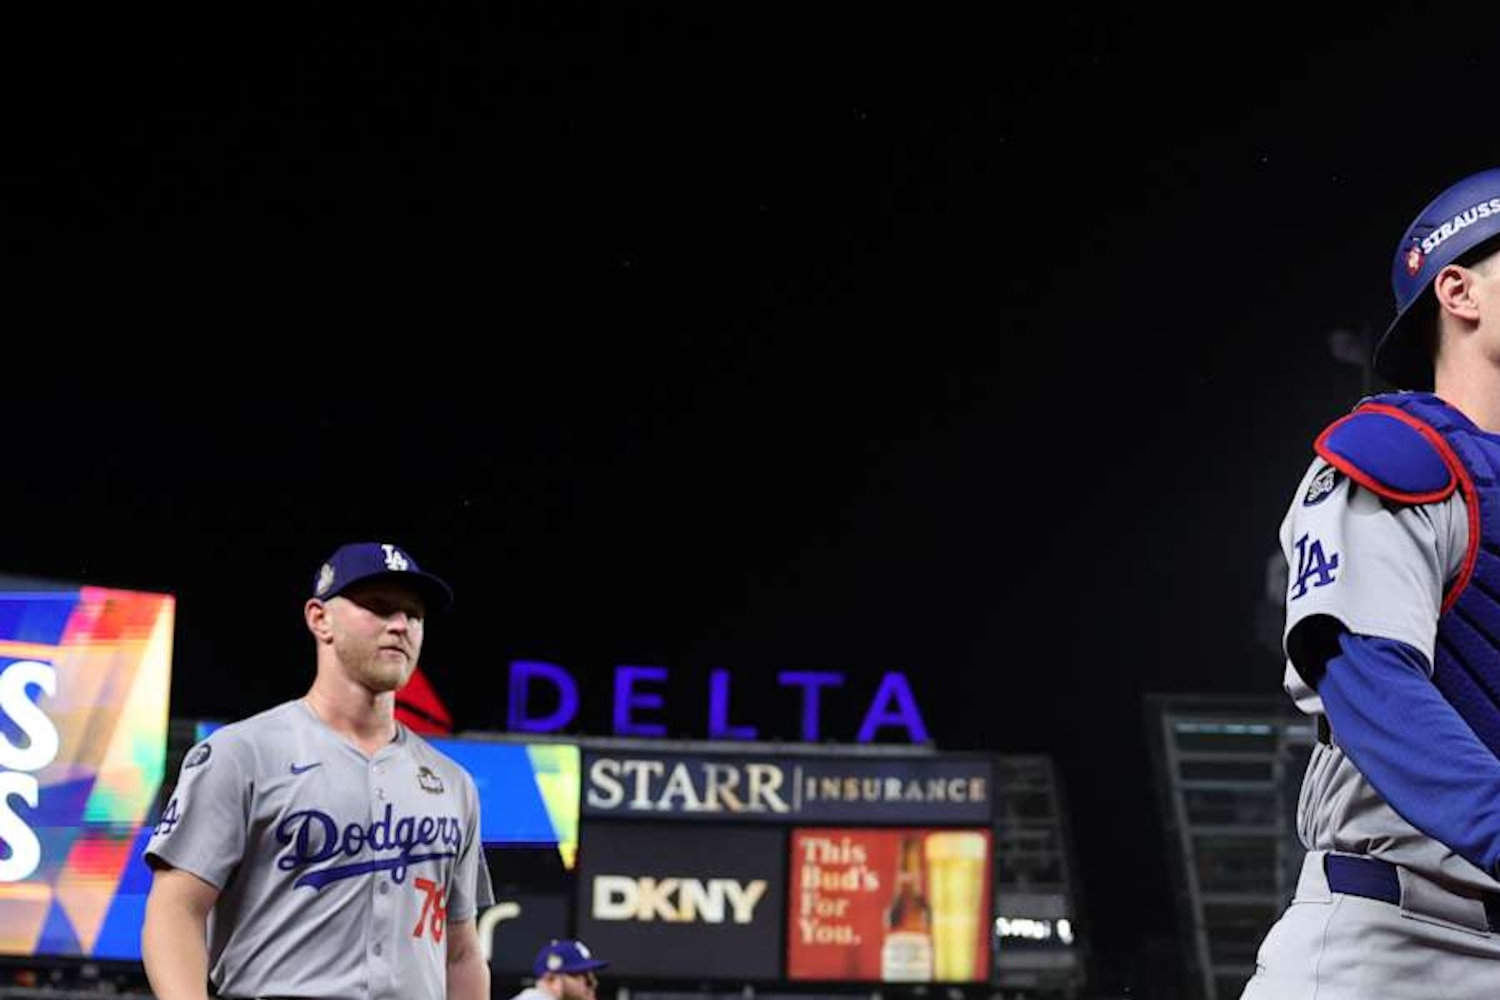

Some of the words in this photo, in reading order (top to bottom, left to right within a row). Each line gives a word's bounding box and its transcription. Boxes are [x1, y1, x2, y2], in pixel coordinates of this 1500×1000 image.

[380, 544, 408, 571] LA
[1290, 532, 1339, 601] LA
[507, 660, 931, 744] DELTA
[587, 758, 792, 813] STARR
[806, 777, 987, 801] INSURANCE
[276, 803, 462, 884] Dodgers
[800, 838, 867, 865] This
[801, 864, 880, 891] Bud's
[592, 876, 767, 924] DKNY
[801, 889, 848, 916] For
[800, 918, 861, 944] You.
